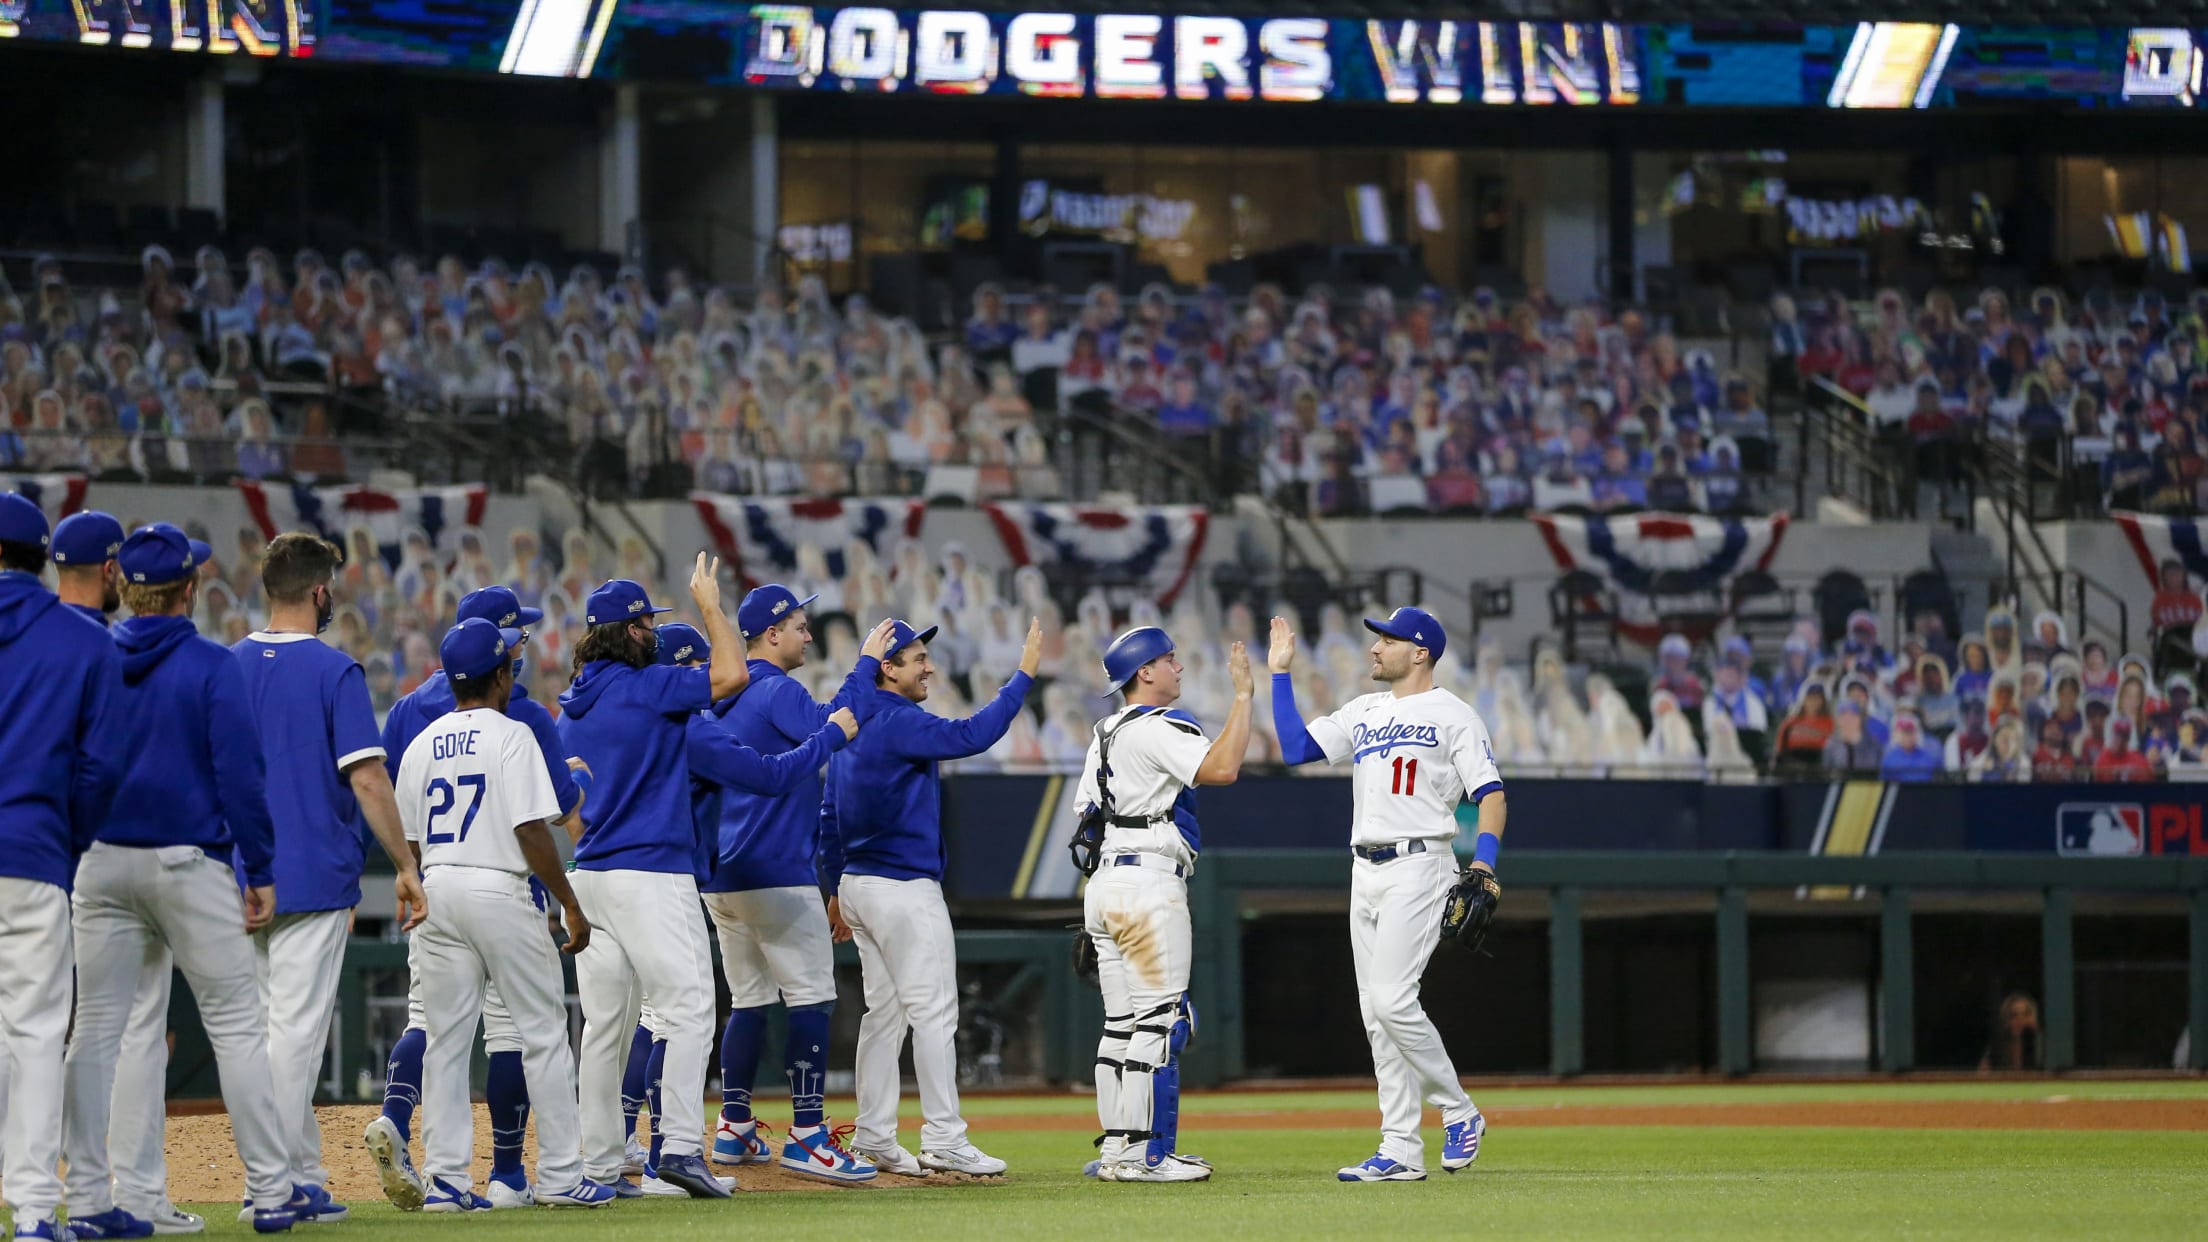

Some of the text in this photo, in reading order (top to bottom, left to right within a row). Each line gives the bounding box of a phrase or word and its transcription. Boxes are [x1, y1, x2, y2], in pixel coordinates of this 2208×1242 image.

[745, 4, 1334, 100] DODGERS
[433, 730, 480, 760] GORE
[1353, 717, 1439, 764] Dodgers
[1392, 756, 1417, 796] 11
[427, 773, 486, 844] 27
